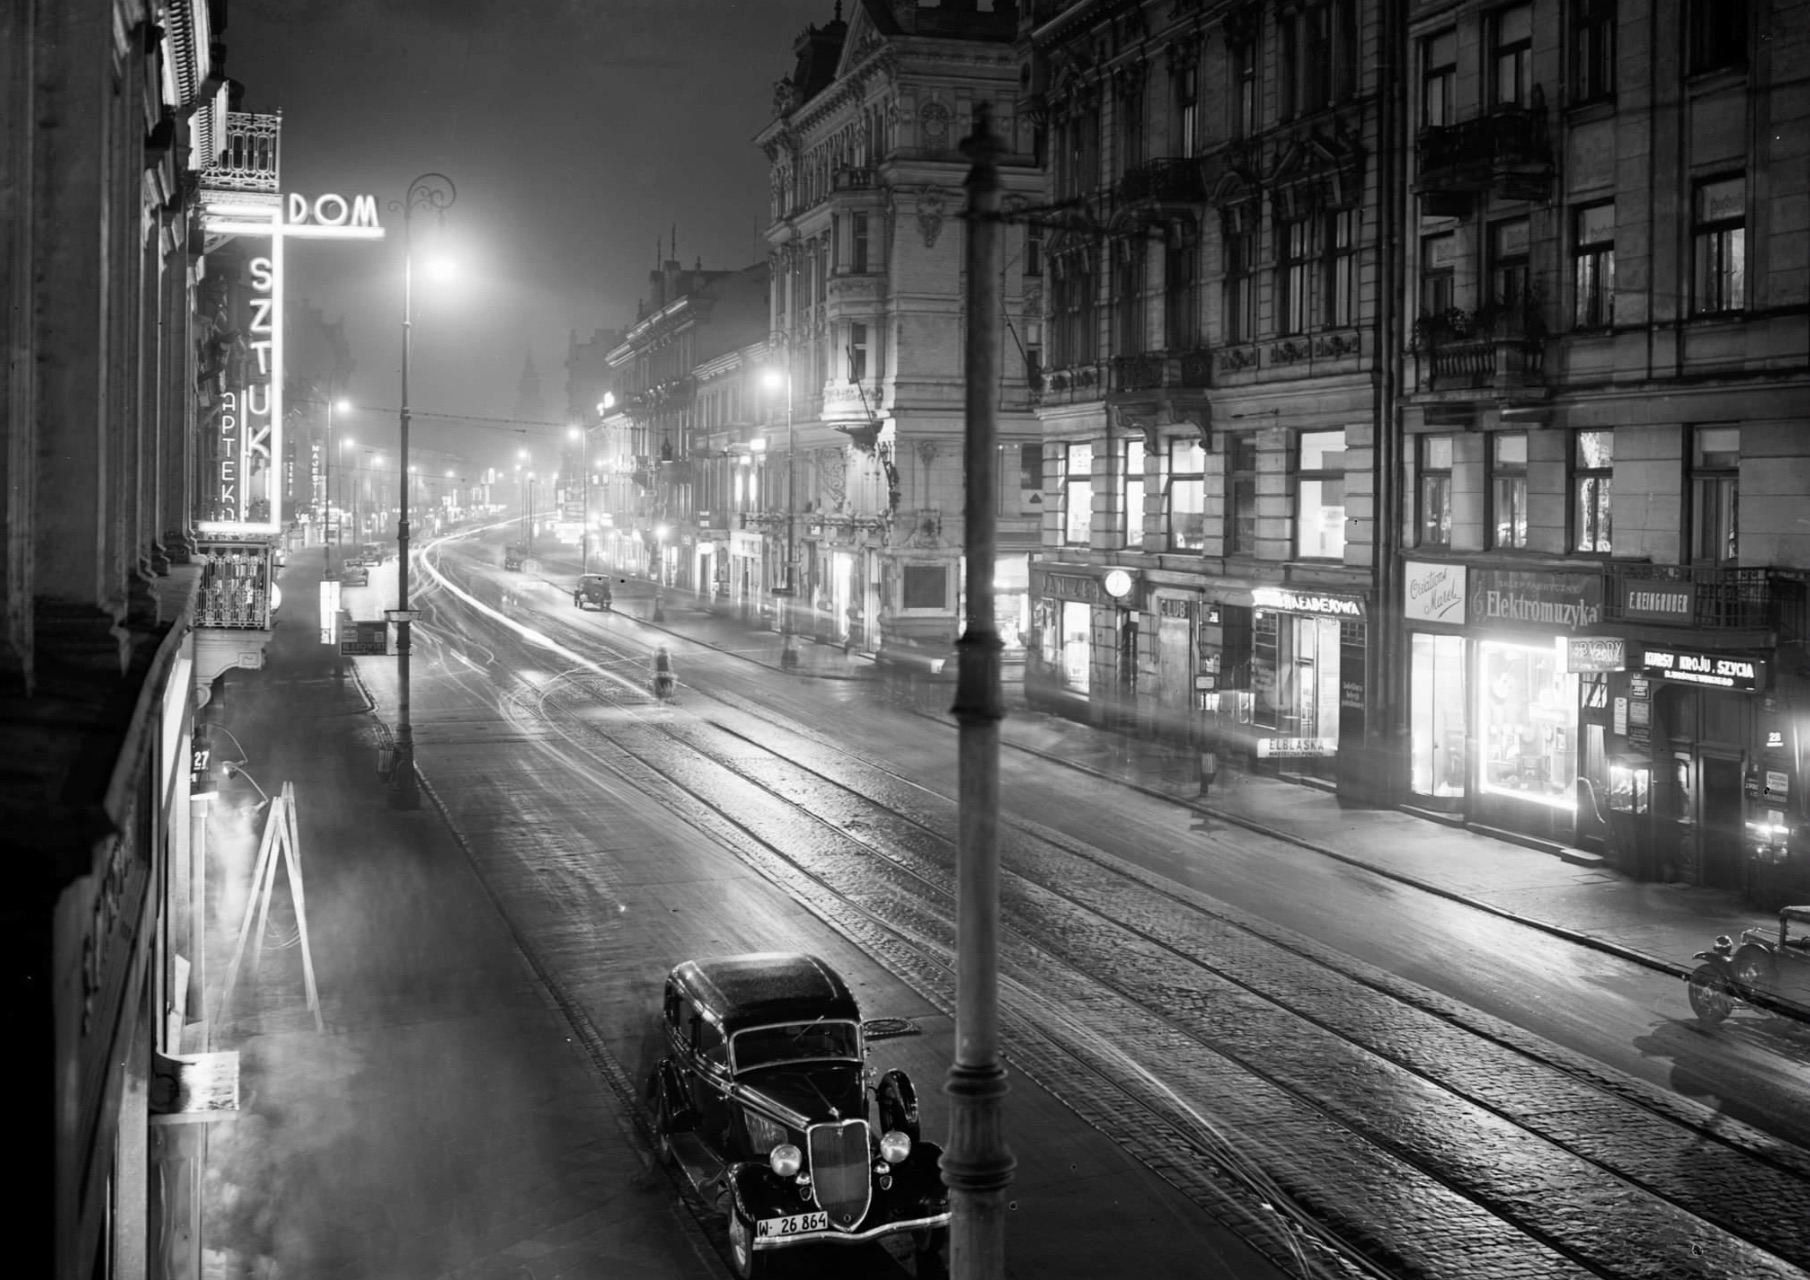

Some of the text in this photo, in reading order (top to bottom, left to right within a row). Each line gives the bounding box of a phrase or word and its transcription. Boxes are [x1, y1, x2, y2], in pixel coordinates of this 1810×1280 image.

[289, 193, 379, 228] DOM
[1160, 600, 1186, 617] CLUB
[1644, 651, 1674, 669] KURSY
[1717, 660, 1754, 678] SZYCIA
[194, 749, 210, 767] 27
[781, 1217, 797, 1234] 26
[802, 1212, 827, 1231] 864
